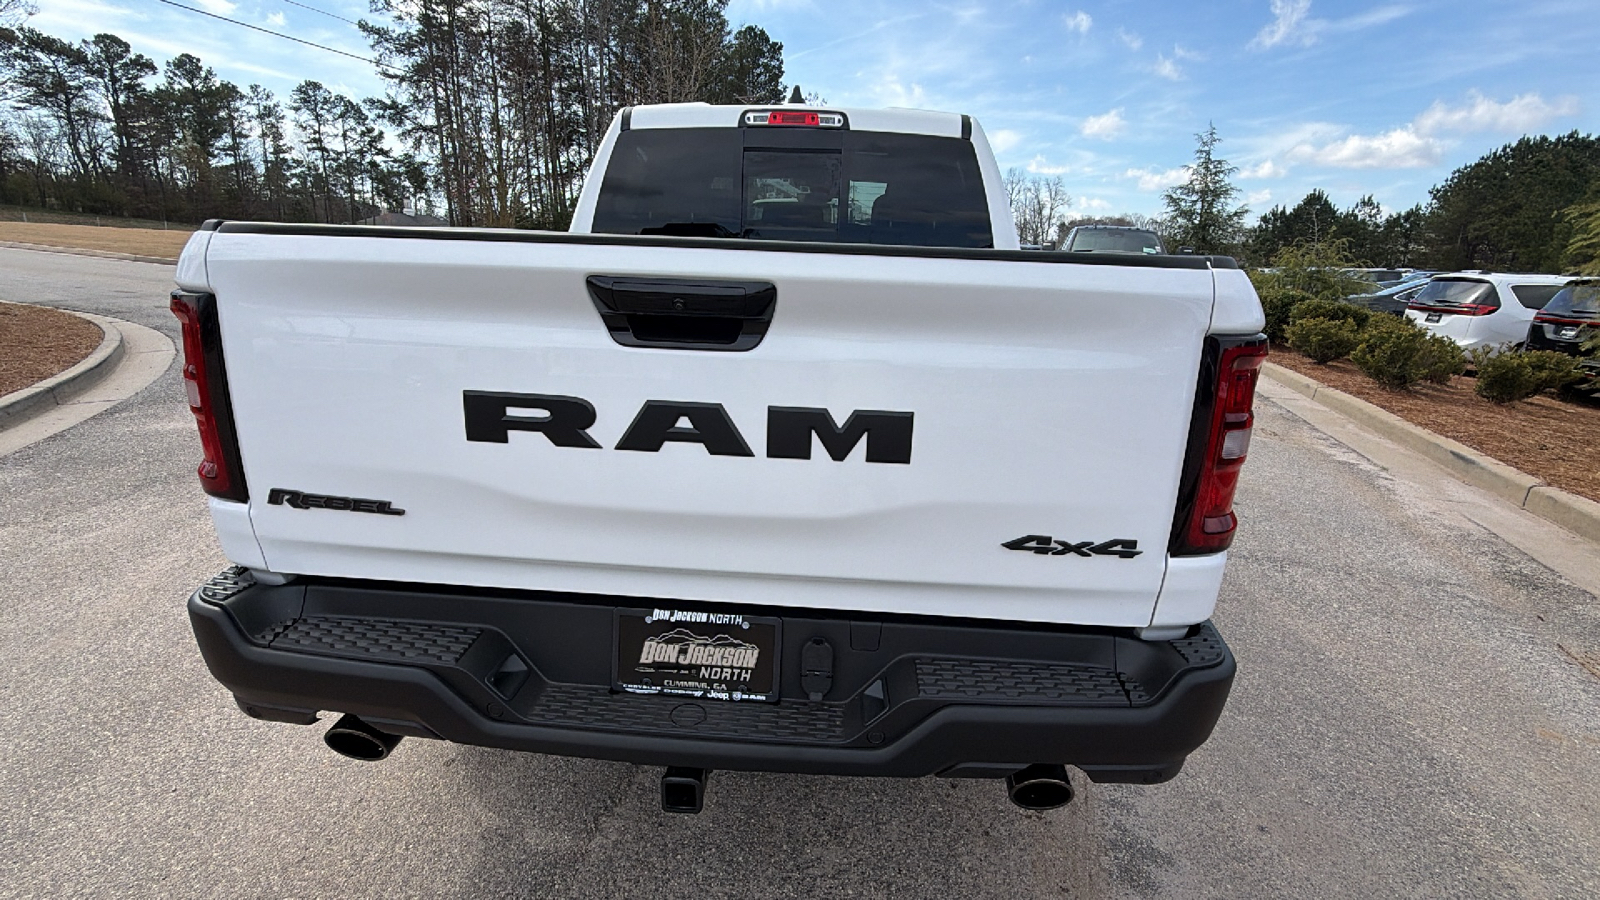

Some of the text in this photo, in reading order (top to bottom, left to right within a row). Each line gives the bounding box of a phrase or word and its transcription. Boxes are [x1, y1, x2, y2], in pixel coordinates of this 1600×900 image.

[463, 389, 915, 465] RAM
[267, 487, 406, 516] REBEL
[1000, 534, 1144, 559] 4x4
[652, 608, 743, 626] DON JACKSON NORTH
[639, 640, 759, 669] DON JACKSON
[699, 666, 752, 682] NORTH
[706, 689, 730, 701] Jeep
[713, 682, 728, 691] GA
